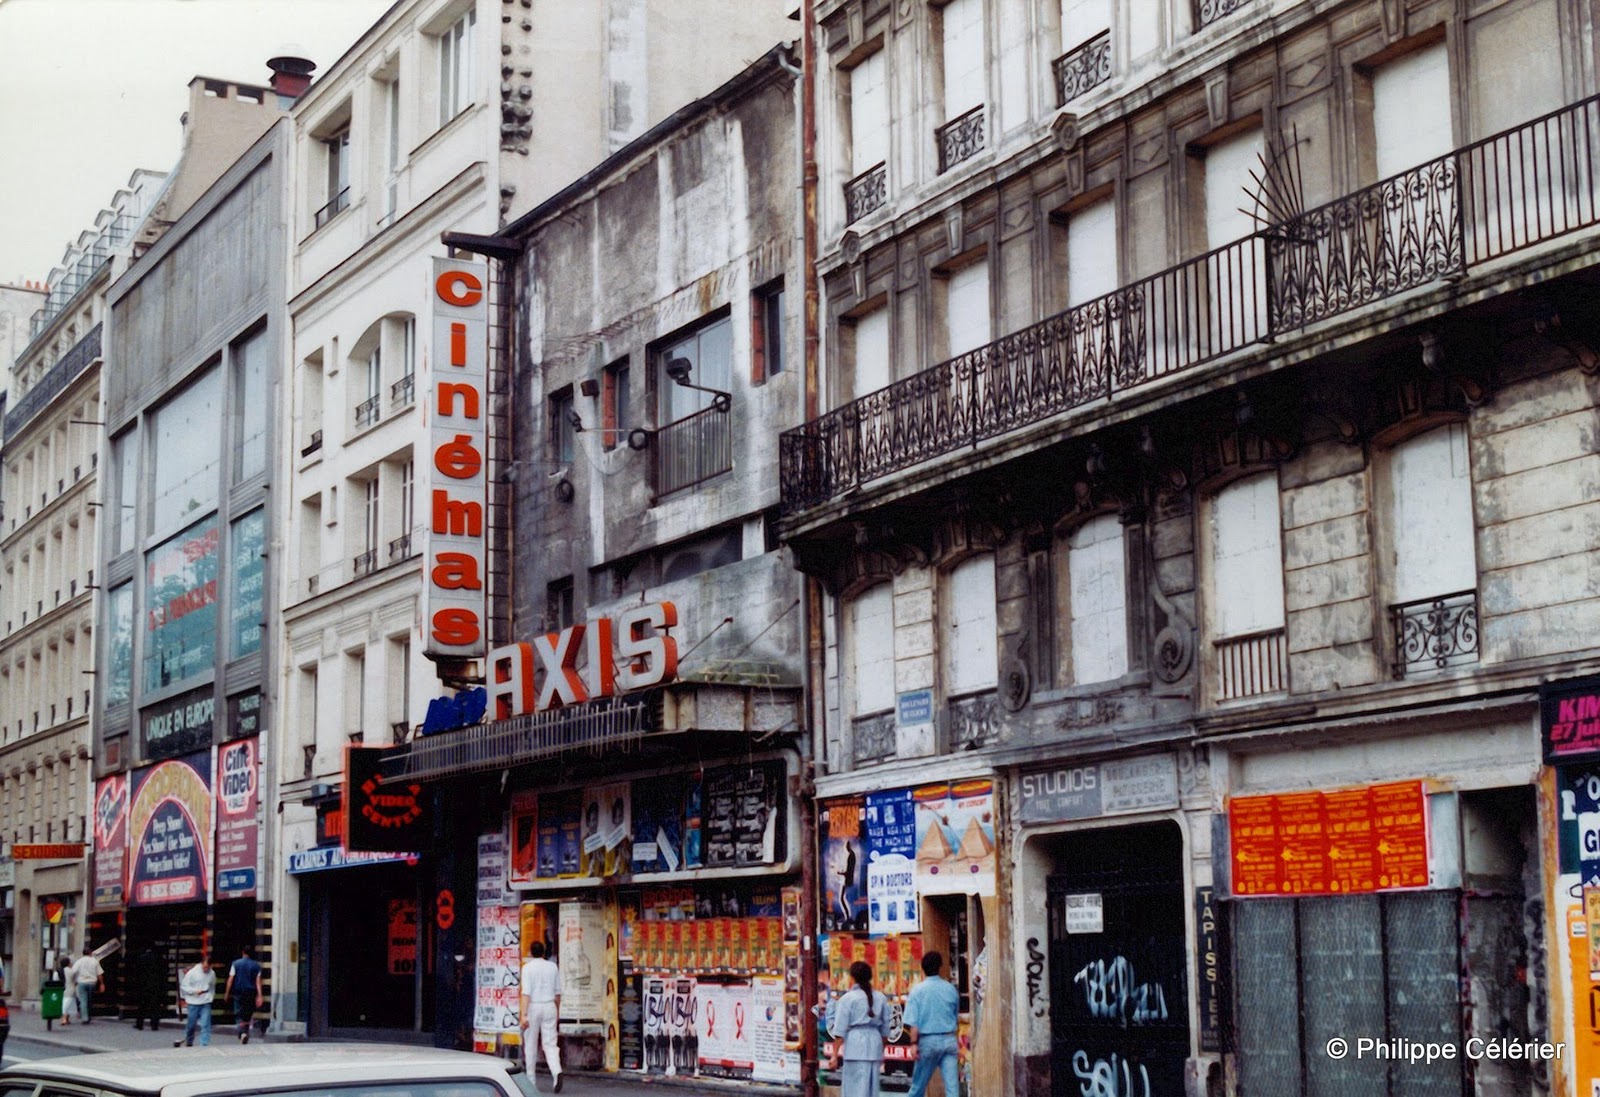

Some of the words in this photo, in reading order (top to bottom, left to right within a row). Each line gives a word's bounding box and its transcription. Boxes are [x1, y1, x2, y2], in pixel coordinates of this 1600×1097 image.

[432, 270, 483, 646] cinémas
[485, 600, 679, 722] AXIS
[146, 713, 172, 742] UNIQUE
[173, 707, 185, 733] EN
[1550, 723, 1574, 741] 27
[1022, 766, 1097, 798] STUDIOS
[1201, 890, 1219, 1029] TAPISSIER
